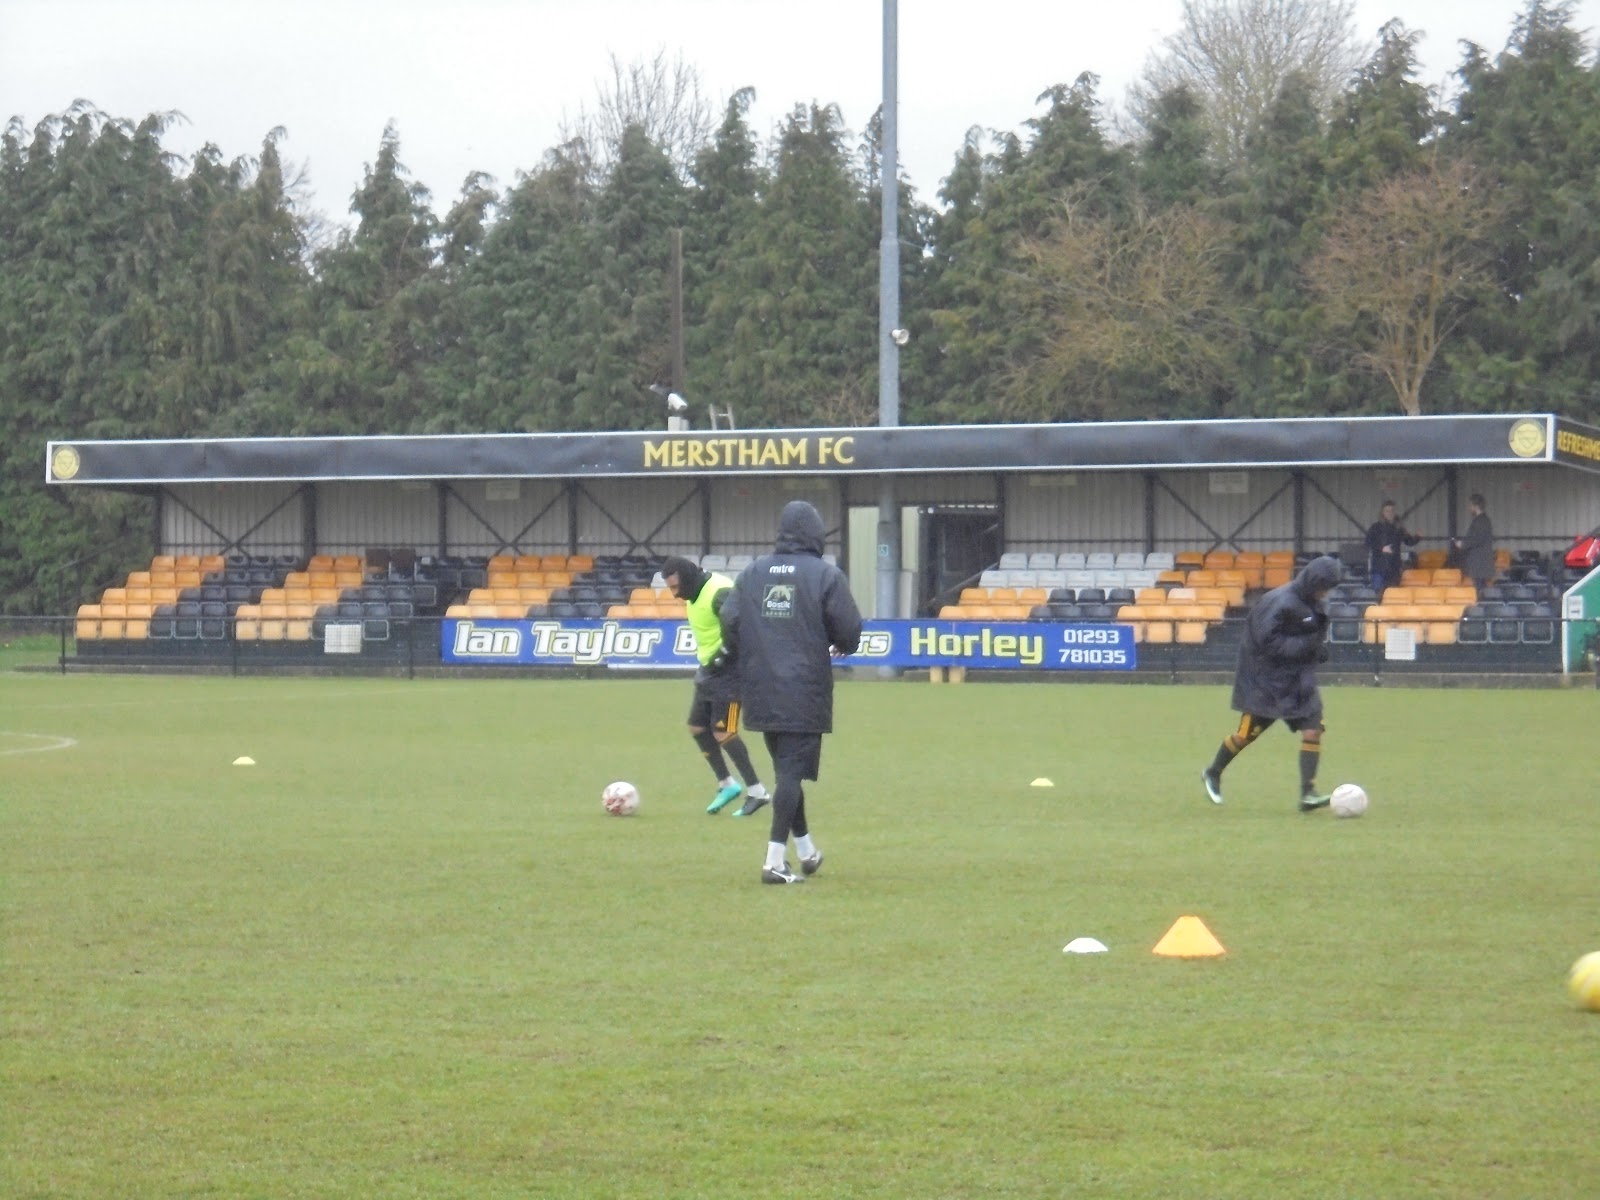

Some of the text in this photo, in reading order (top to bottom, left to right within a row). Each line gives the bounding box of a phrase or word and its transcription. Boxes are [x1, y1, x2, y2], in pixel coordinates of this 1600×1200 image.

[643, 436, 855, 467] MERSTHAM FC
[454, 622, 521, 656] Ian
[532, 622, 661, 663] Taylor
[910, 627, 1043, 664] Horley
[1063, 629, 1120, 645] 01293
[1058, 648, 1126, 664] 781035
